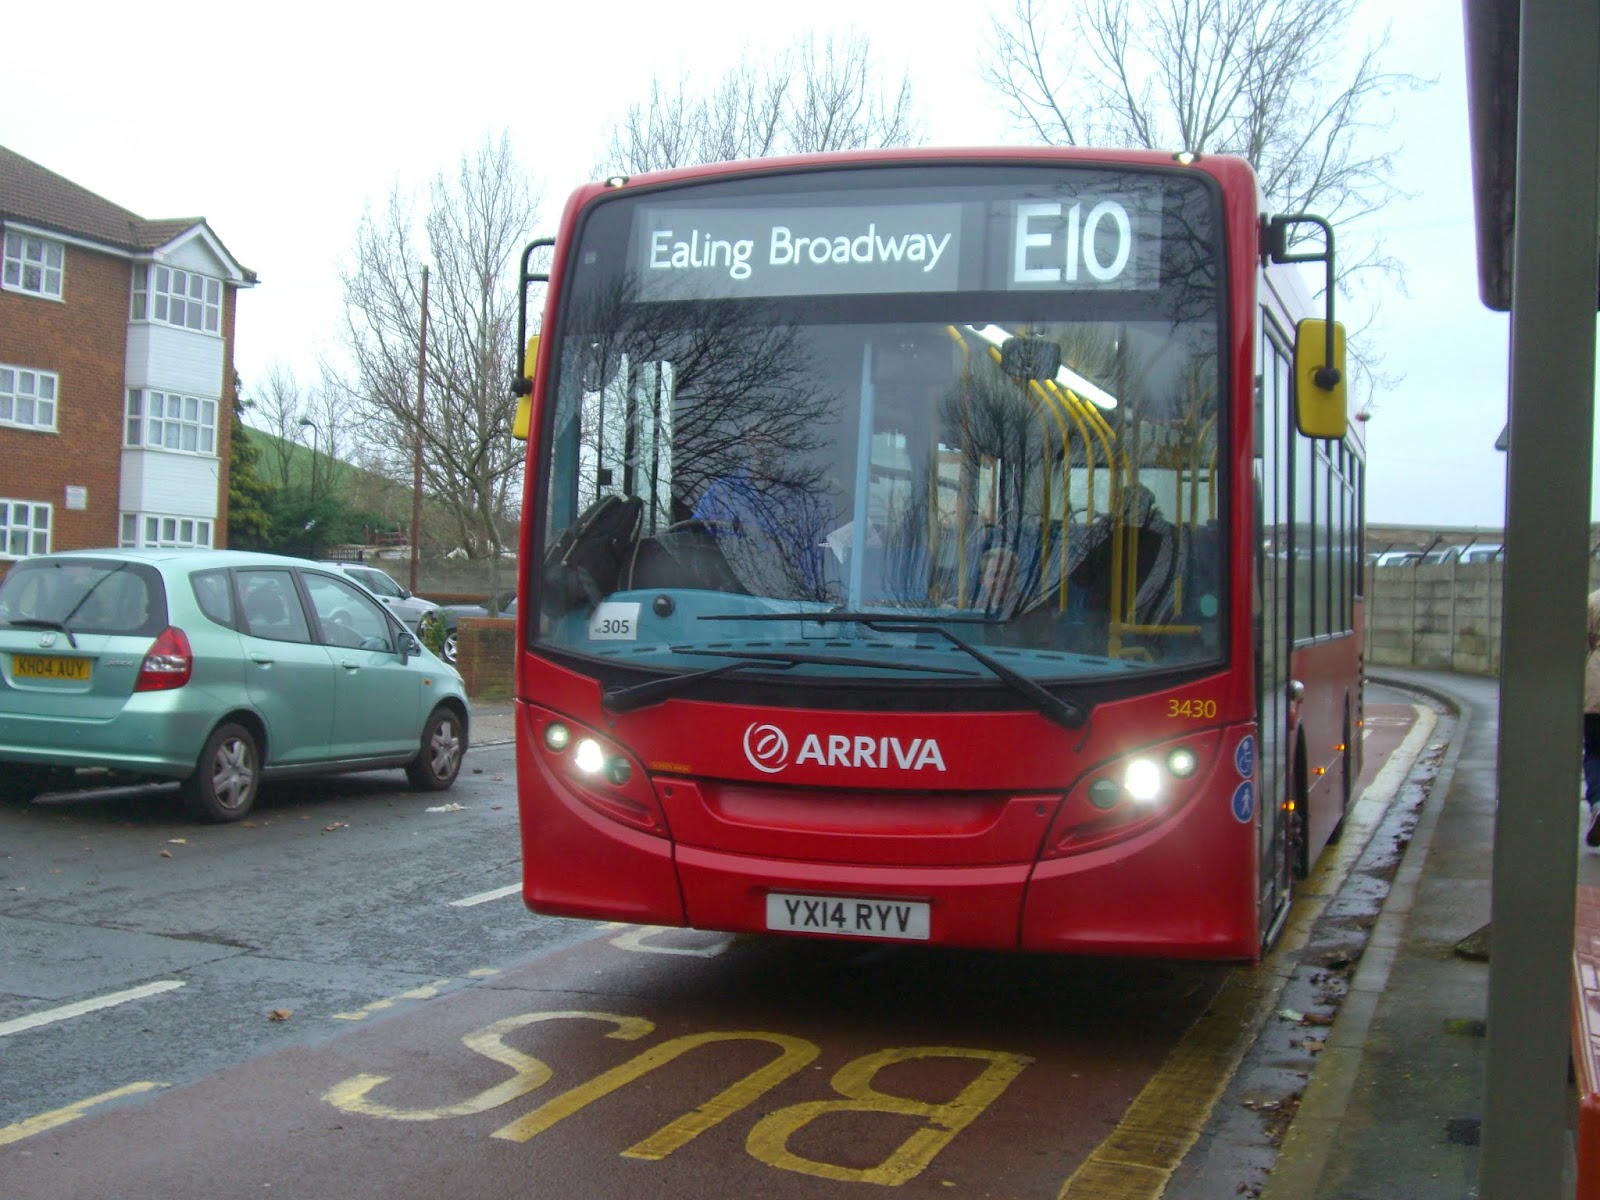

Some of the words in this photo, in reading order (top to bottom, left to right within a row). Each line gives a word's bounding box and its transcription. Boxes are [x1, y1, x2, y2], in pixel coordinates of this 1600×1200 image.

[650, 229, 754, 280] Ealing
[769, 223, 952, 273] Broadway
[1013, 200, 1132, 283] E10
[602, 619, 630, 634] 305
[18, 656, 53, 675] KH04
[57, 658, 85, 678] AUY
[1167, 699, 1217, 718] 3430
[796, 734, 947, 772] ARRIVA
[785, 899, 846, 928] YX14
[856, 903, 911, 932] RYV
[322, 1010, 1033, 1187] BUS
